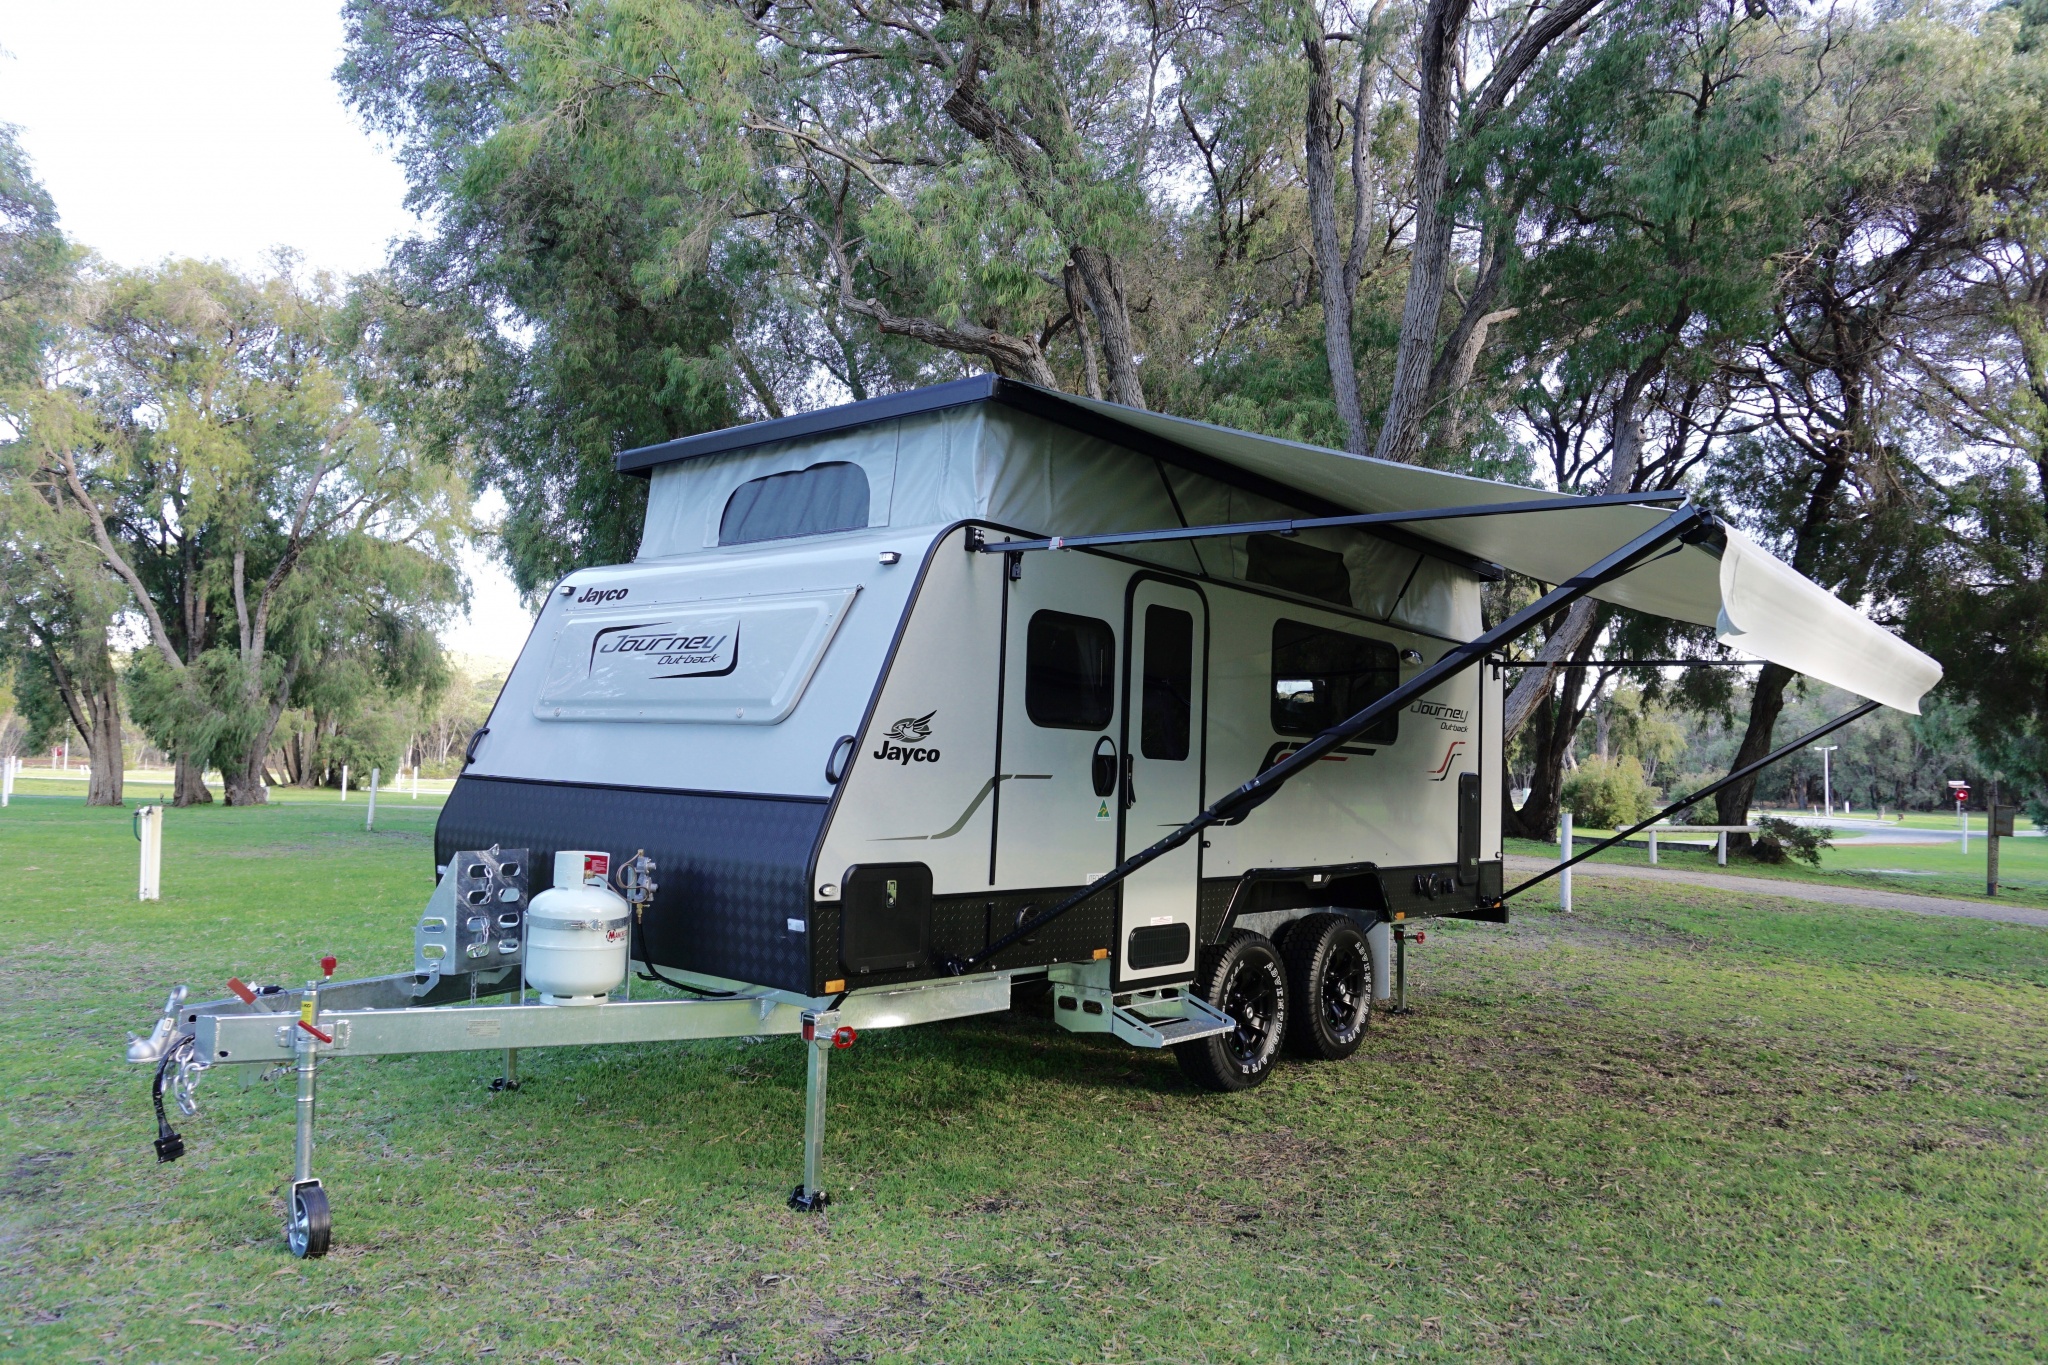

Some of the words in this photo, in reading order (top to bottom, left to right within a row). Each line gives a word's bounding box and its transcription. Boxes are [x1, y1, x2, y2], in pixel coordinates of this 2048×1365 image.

[578, 588, 629, 605] Jayco
[600, 633, 727, 655] Journey
[657, 653, 720, 665] Outback
[1410, 699, 1468, 722] Journey
[1440, 722, 1469, 733] Outback
[873, 740, 941, 766] Jayco
